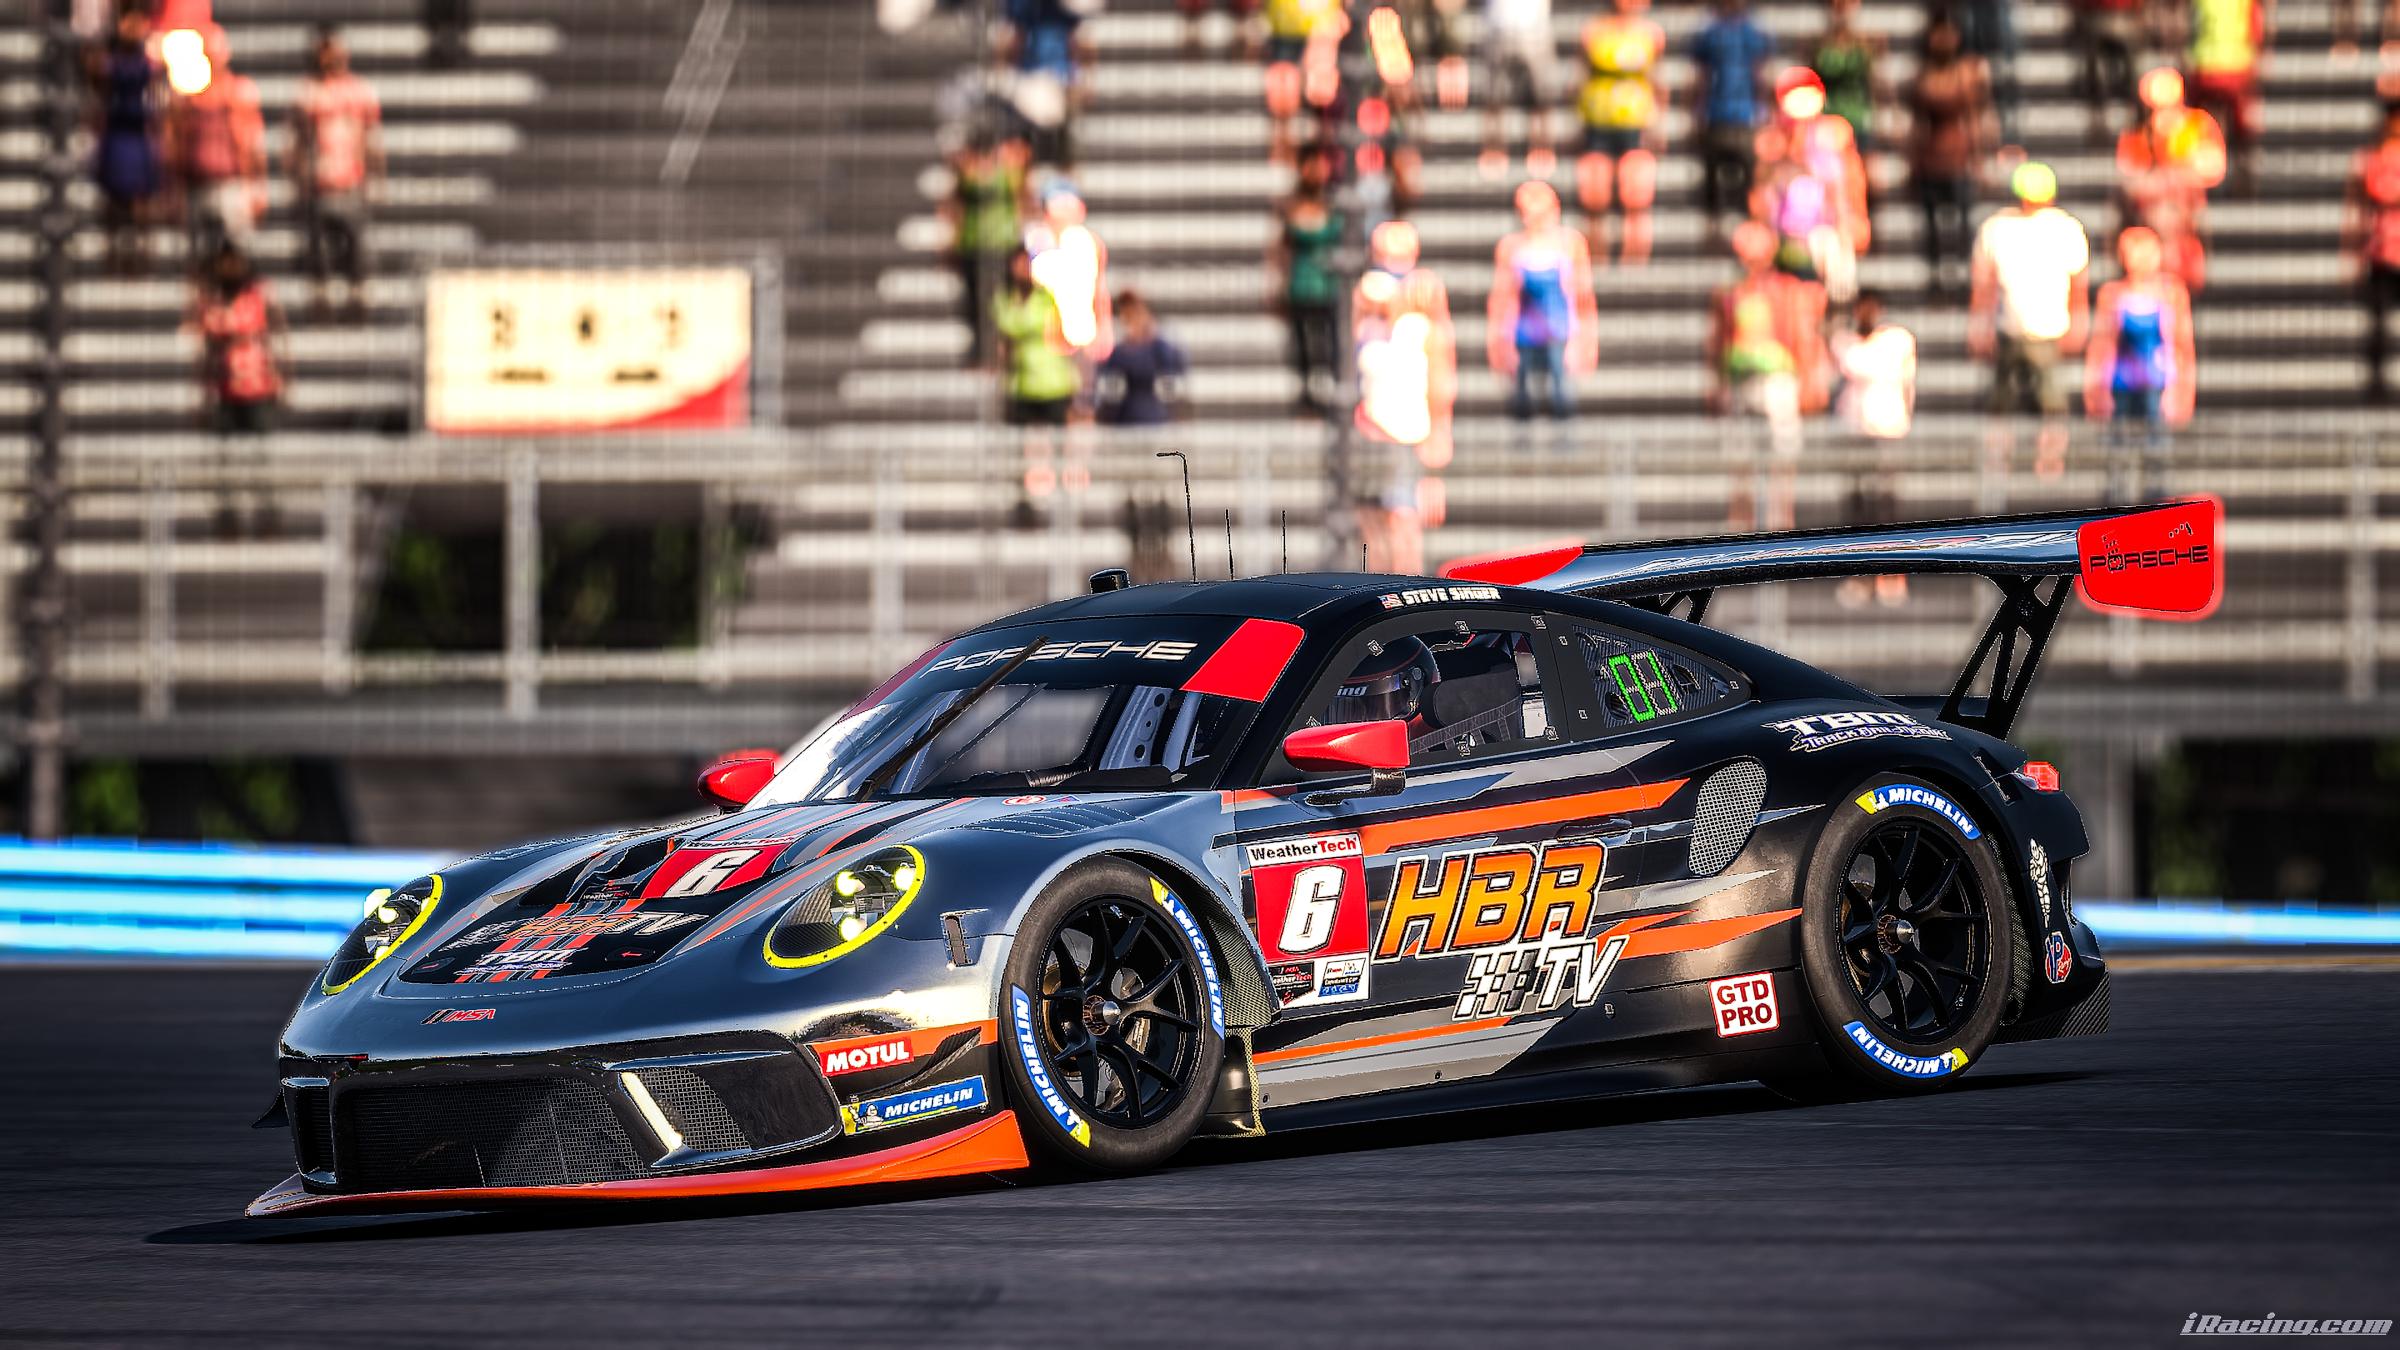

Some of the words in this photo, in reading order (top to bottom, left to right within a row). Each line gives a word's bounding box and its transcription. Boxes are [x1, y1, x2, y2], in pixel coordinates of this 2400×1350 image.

[2089, 545, 2209, 573] PORSCHE
[1401, 588, 1449, 605] STEVE
[1888, 787, 1974, 835] MICHELIN
[1250, 837, 1357, 861] WeatherTech
[662, 849, 764, 898] 6
[1277, 864, 1347, 955] 6
[1373, 841, 1606, 961] HBR
[1172, 907, 1224, 1028] MICHELIN
[1537, 935, 1630, 1009] TV
[1716, 979, 1770, 1005] GTD
[1721, 1003, 1772, 1030] PRO
[825, 1041, 910, 1073] MOTUL
[1014, 998, 1068, 1121] MICHELIN
[1851, 1026, 1941, 1074] MICHELIN
[884, 1087, 974, 1119] MICHELIN
